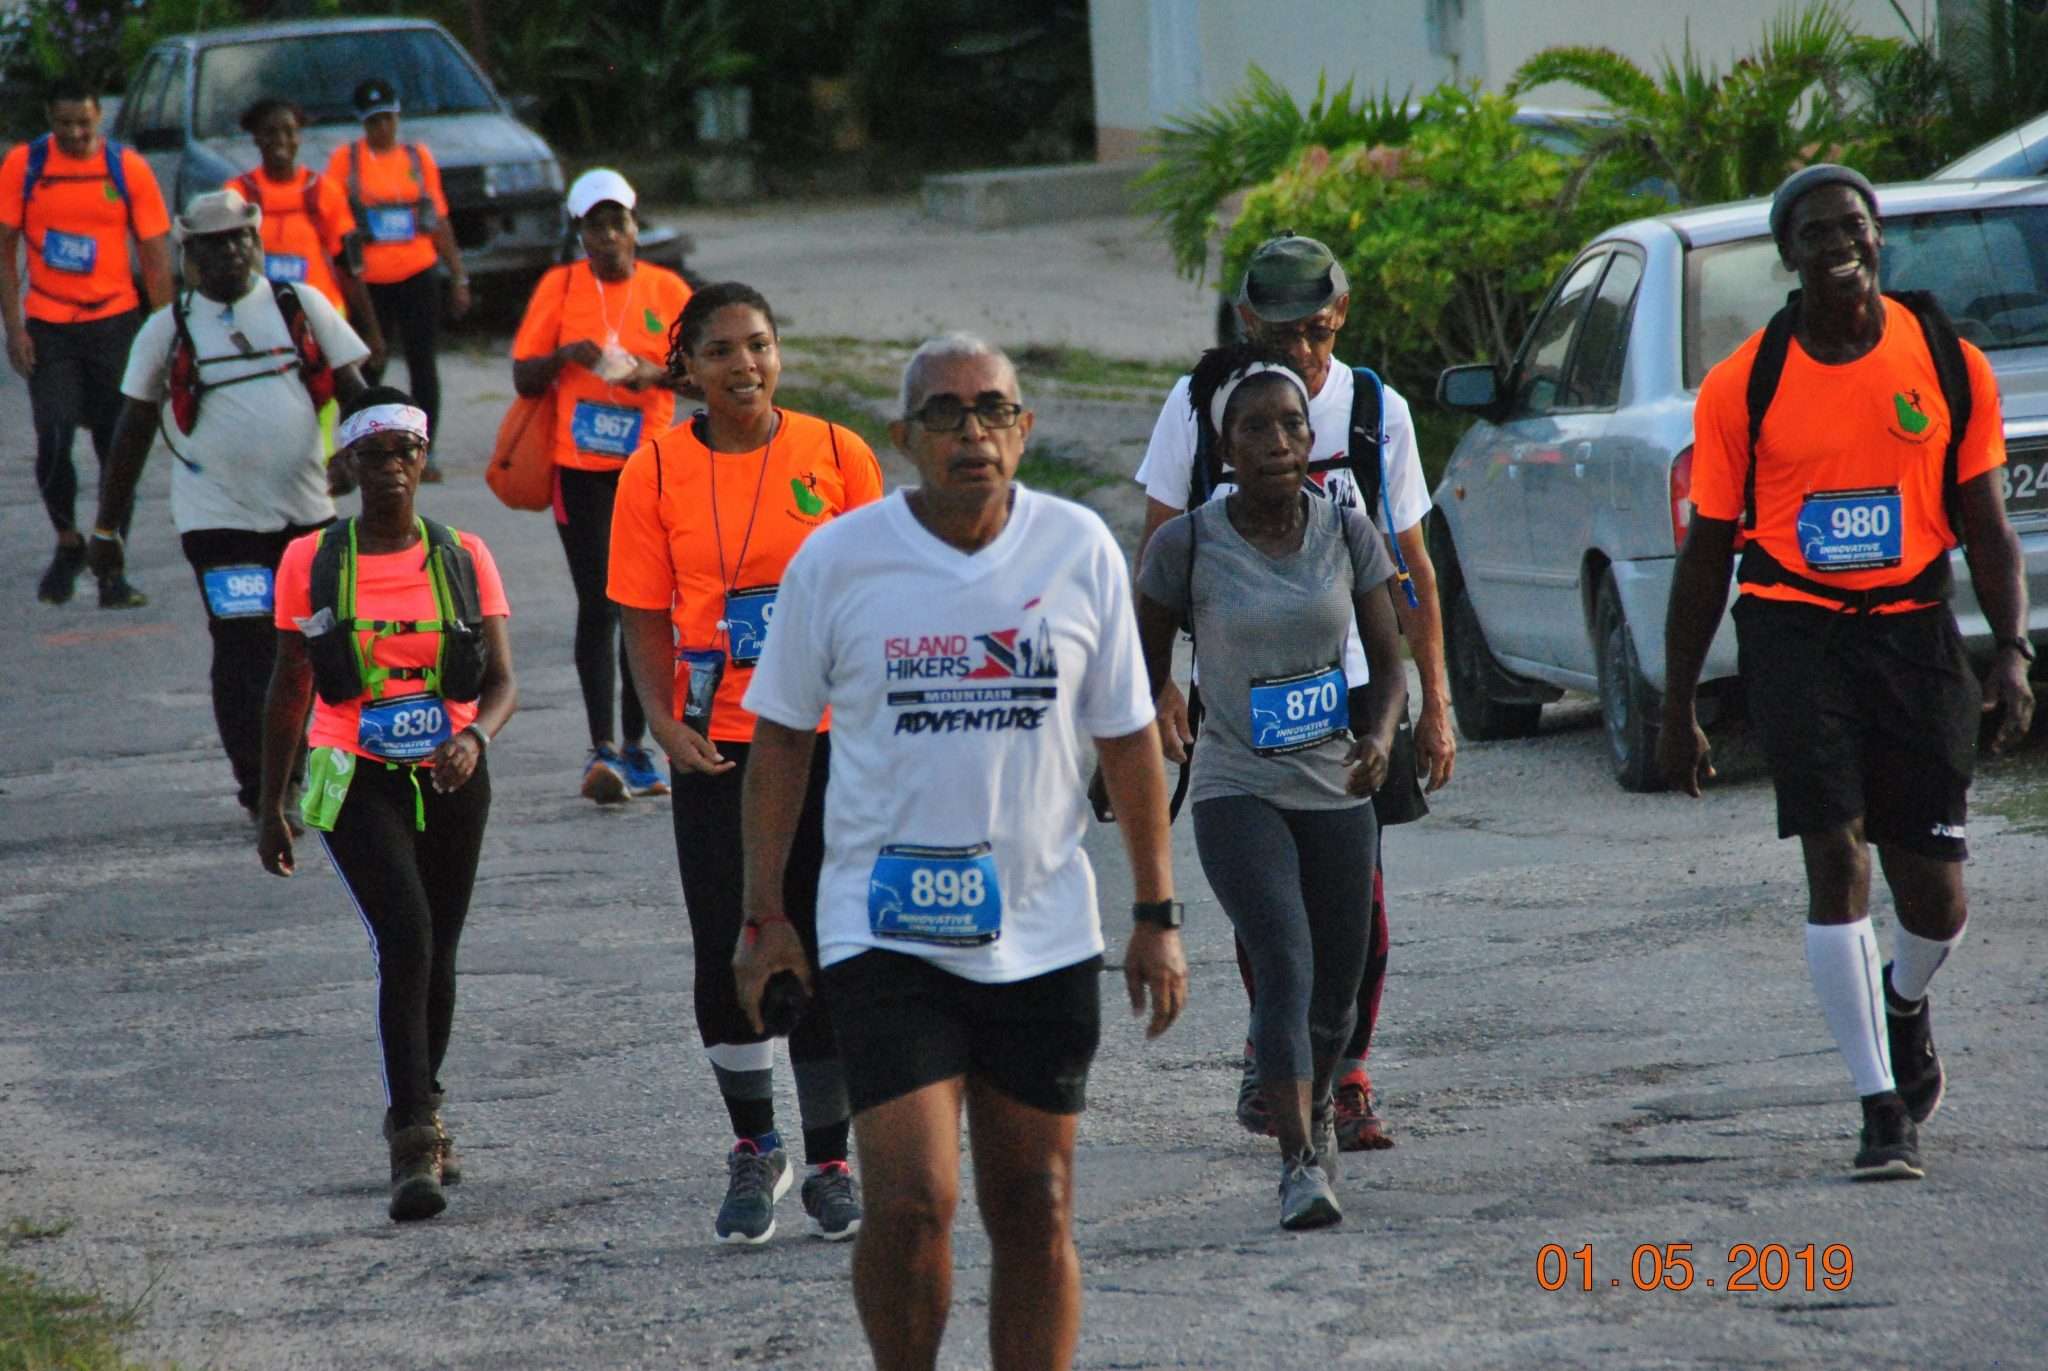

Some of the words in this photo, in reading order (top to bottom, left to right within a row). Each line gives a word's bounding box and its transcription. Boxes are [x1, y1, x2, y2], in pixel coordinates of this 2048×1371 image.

[594, 413, 635, 439] 967
[1831, 505, 1890, 539] 980
[226, 574, 267, 598] 966
[884, 635, 968, 659] ISLAND
[886, 656, 971, 681] HIKERS
[923, 689, 1013, 703] MOUNTAIN
[1286, 682, 1338, 720] 870
[392, 706, 442, 737] 830
[894, 706, 1049, 736] ADVENTURE
[1276, 719, 1330, 738] INNOVATIVE
[911, 868, 985, 907] 898
